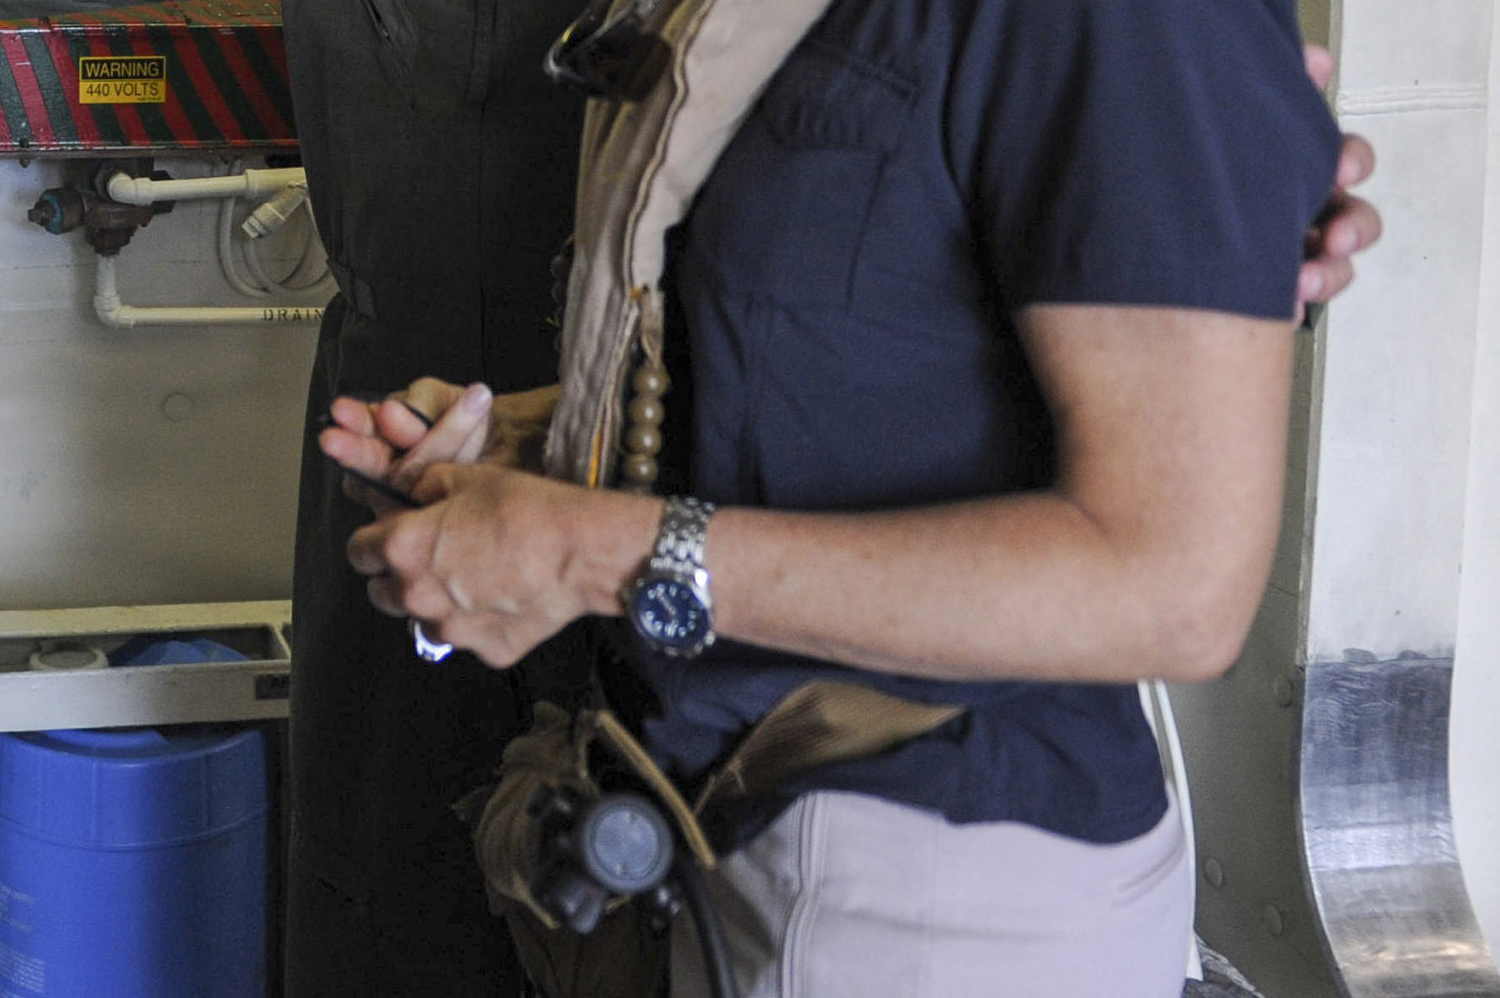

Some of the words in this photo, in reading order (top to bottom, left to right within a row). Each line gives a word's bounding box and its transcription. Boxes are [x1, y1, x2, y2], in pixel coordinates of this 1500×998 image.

[85, 62, 159, 78] WARNING
[86, 83, 110, 97] 440
[113, 82, 159, 96] VOLTS
[263, 308, 325, 321] DRAIN
